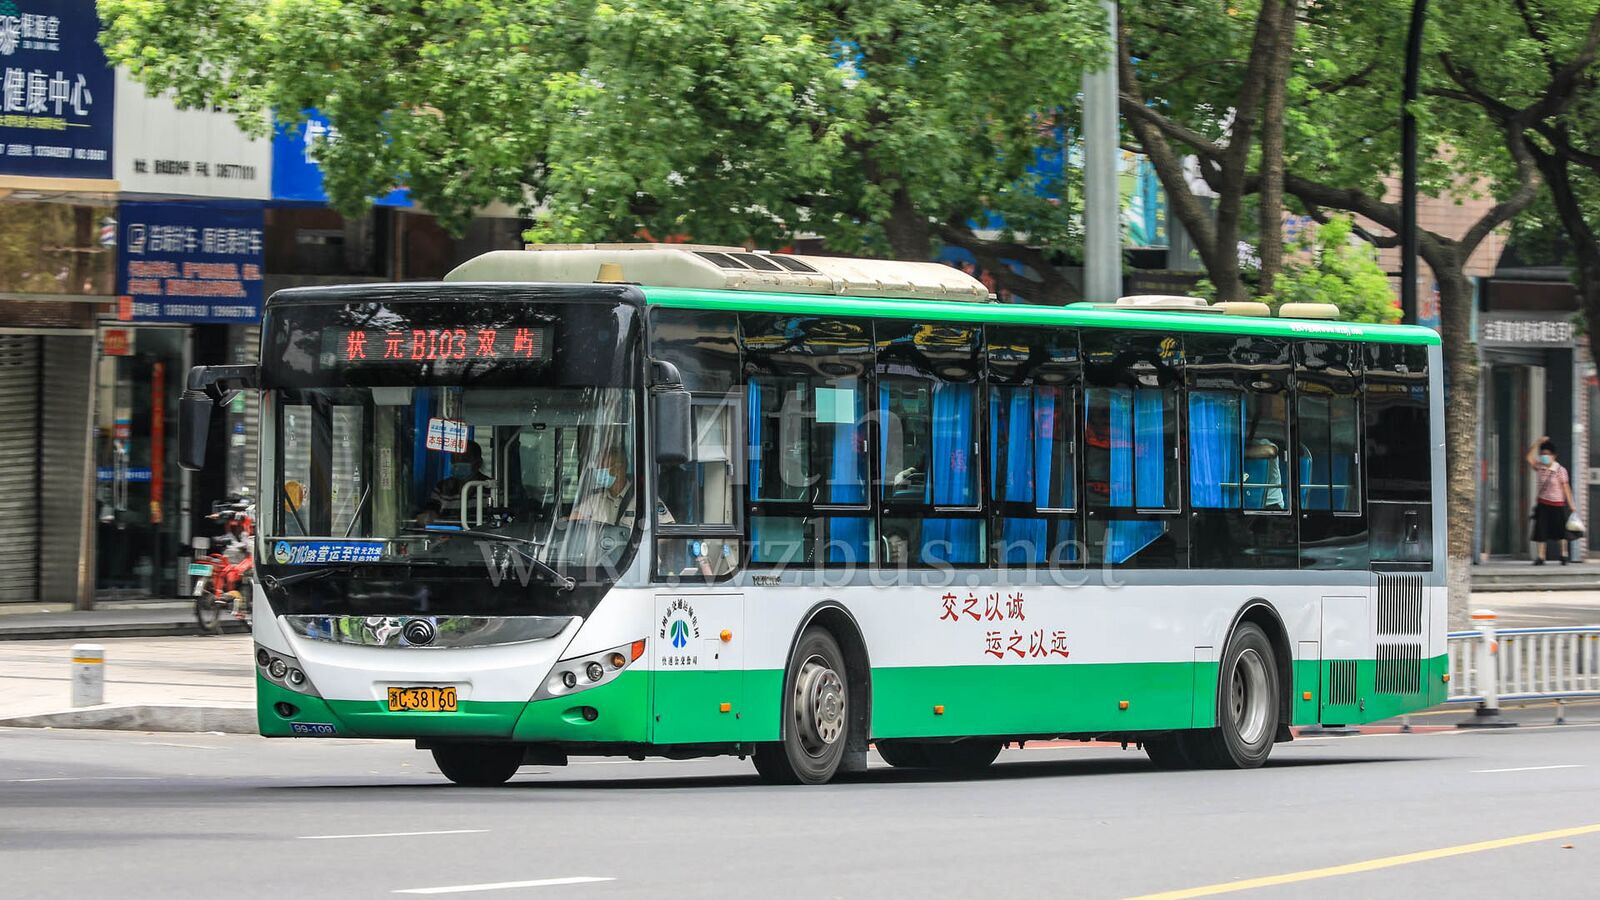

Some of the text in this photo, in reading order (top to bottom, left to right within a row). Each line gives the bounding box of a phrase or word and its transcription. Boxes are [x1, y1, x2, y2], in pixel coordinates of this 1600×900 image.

[0, 67, 93, 116] 健康中心
[346, 328, 535, 360] 状元 B103 双屿
[940, 592, 1026, 622] 交之以诚
[984, 629, 1070, 660] 运之以远
[294, 725, 332, 734] 99-109
